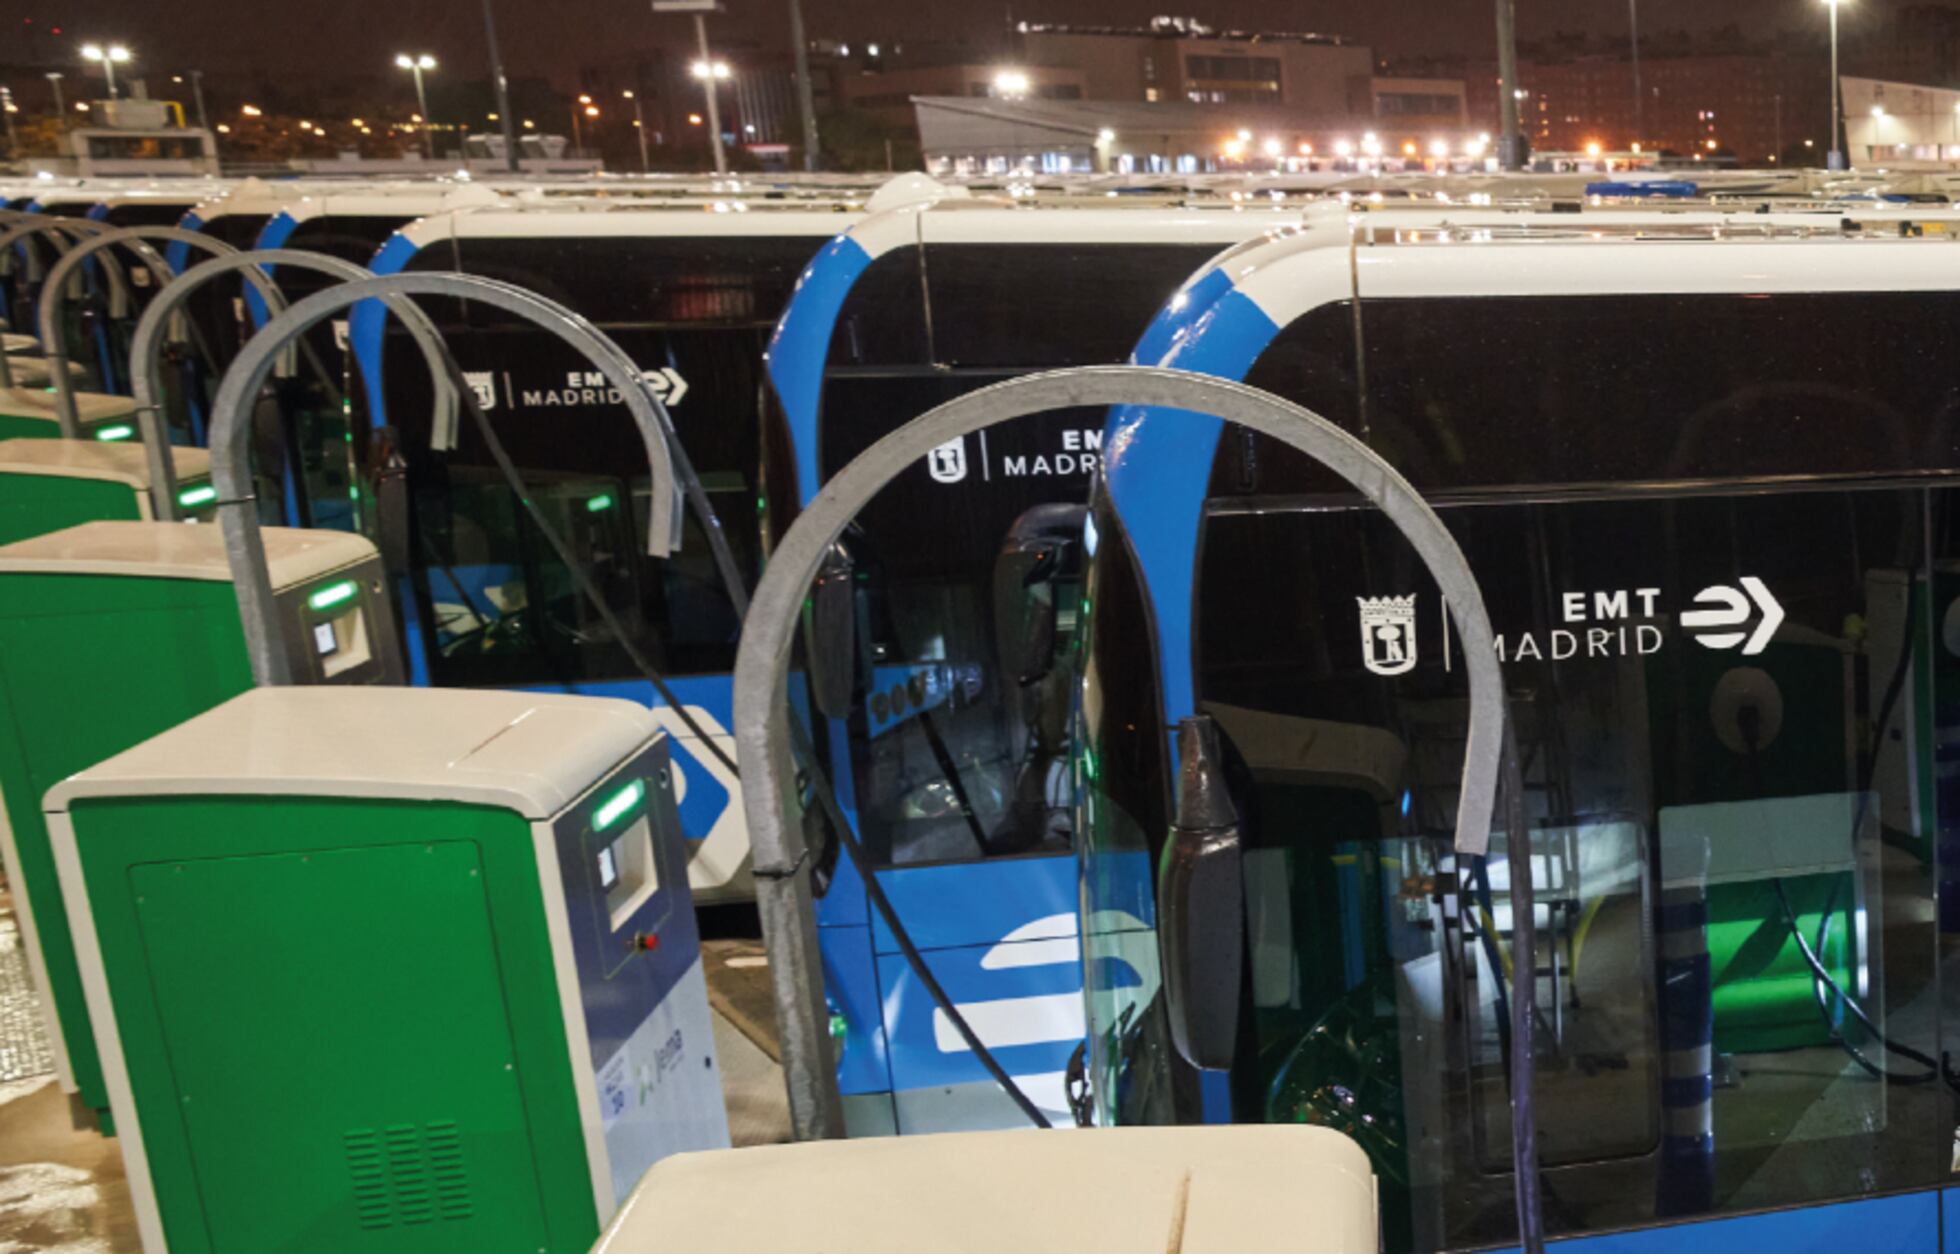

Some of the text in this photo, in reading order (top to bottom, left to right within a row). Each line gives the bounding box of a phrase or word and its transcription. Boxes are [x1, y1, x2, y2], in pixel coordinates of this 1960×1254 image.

[567, 372, 605, 388] EM
[524, 389, 624, 406] MADRID
[1062, 429, 1104, 450] EM
[1004, 453, 1097, 476] MADR
[1563, 588, 1661, 622] EMT
